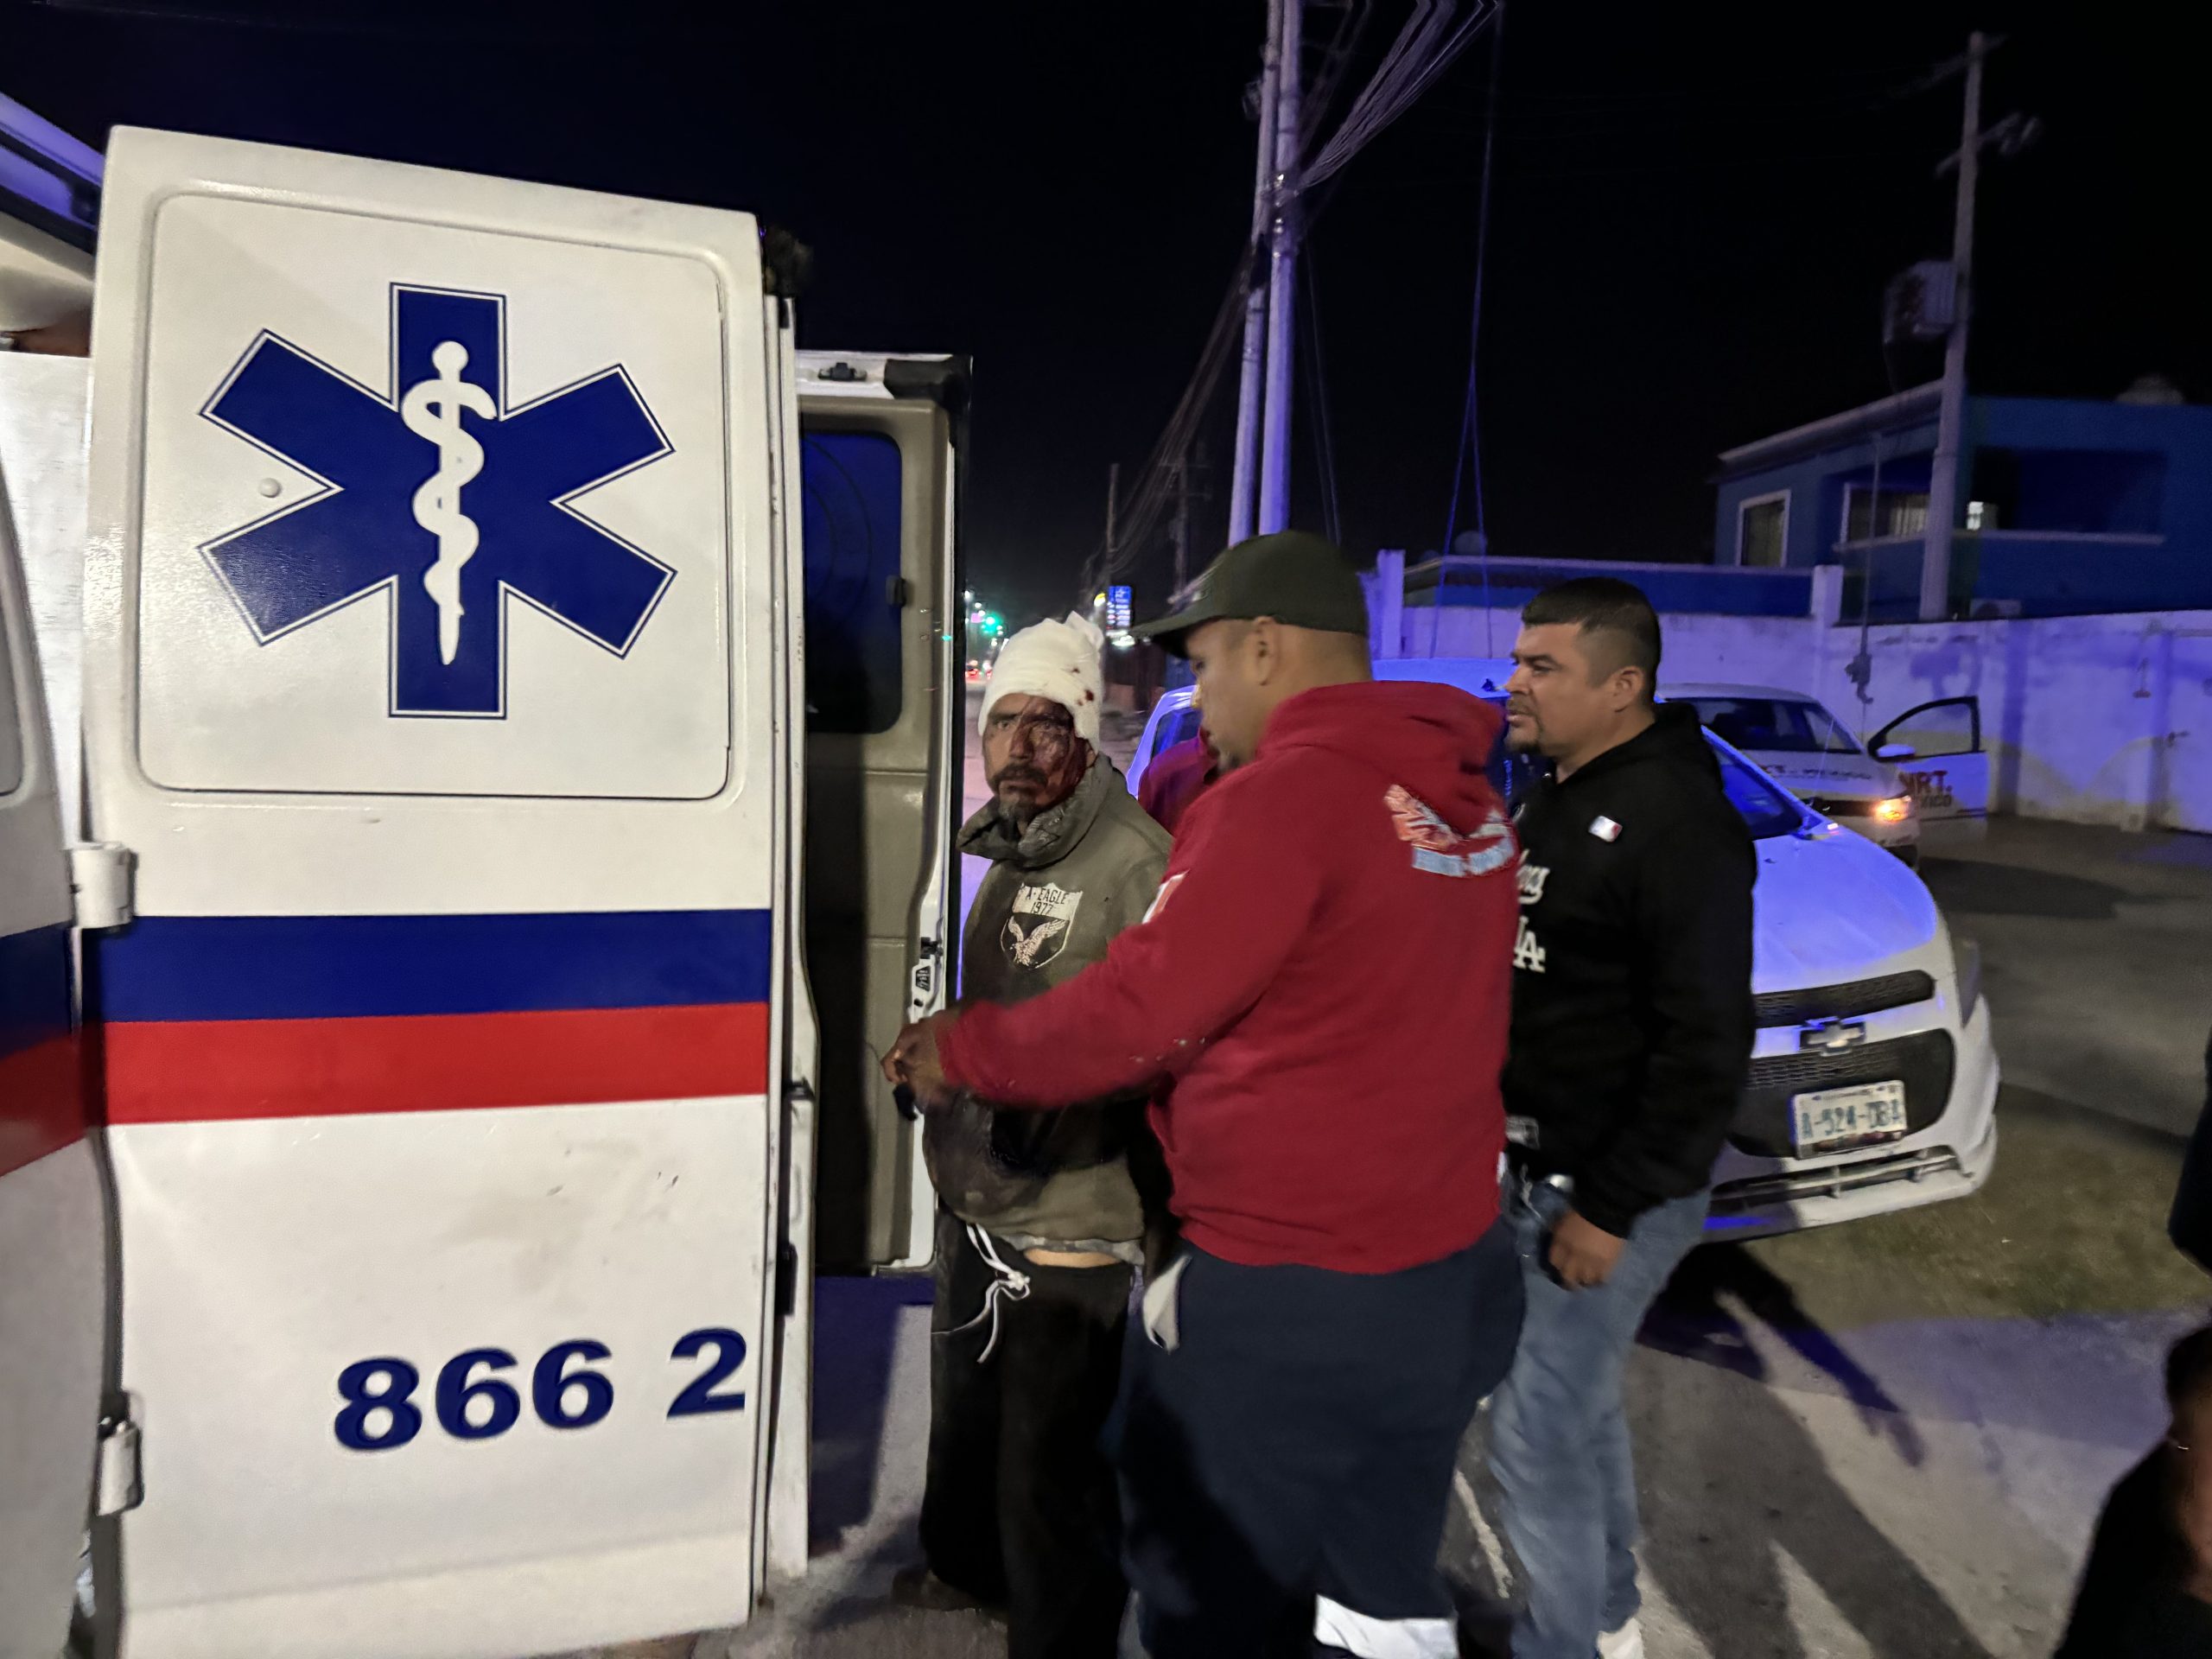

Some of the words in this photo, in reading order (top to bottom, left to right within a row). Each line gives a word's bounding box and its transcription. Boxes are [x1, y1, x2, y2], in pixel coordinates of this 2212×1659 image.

[1037, 887, 1070, 905] EAGLE
[334, 1338, 614, 1452] 866
[666, 1326, 747, 1419] 2
